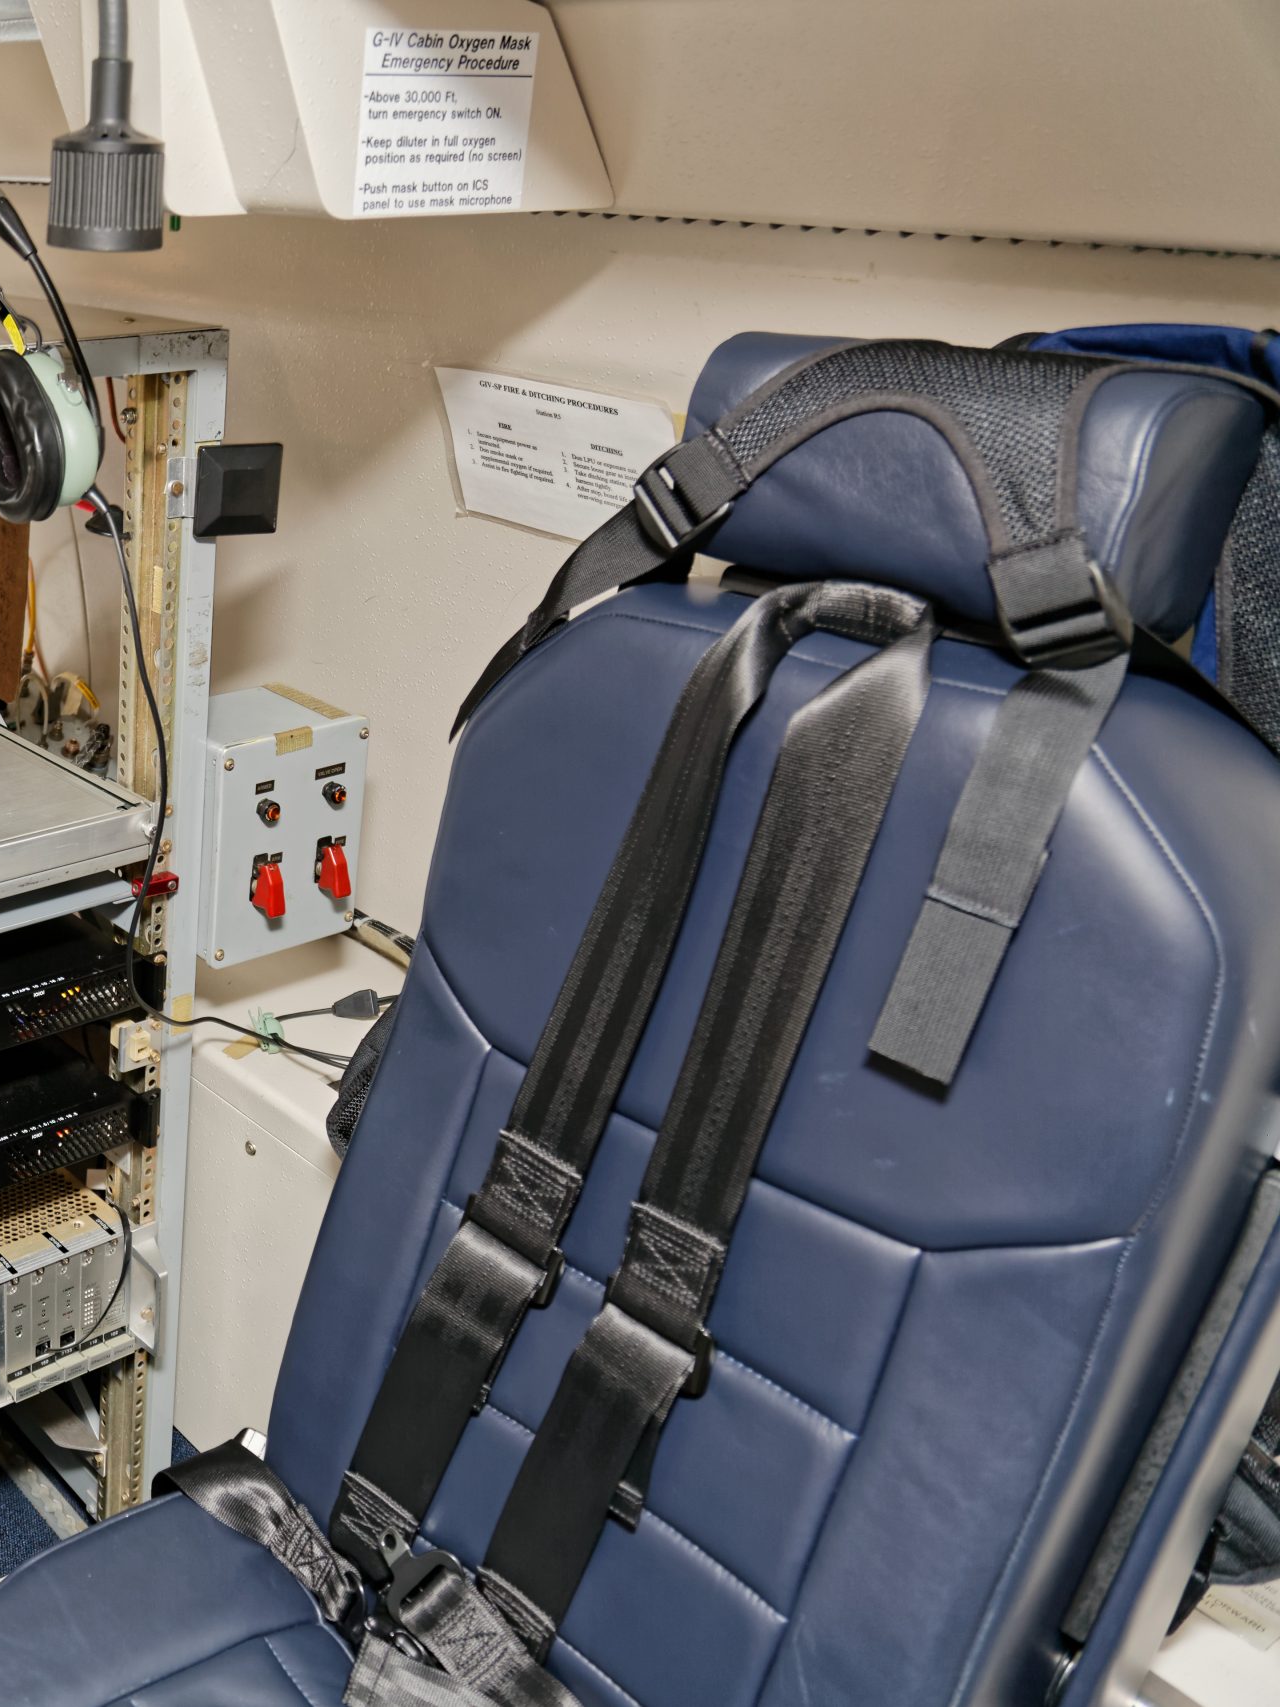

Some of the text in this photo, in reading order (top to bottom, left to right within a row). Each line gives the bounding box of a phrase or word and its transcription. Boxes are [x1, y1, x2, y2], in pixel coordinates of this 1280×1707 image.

[373, 32, 532, 52] G-IV Cabin Oxygen Mask
[382, 53, 520, 72] Emergency Procedure
[364, 92, 400, 103] -Above
[405, 91, 441, 103] 30,000
[369, 107, 502, 121] turn emergency switch ON.
[362, 136, 495, 149] -Keep diluter in full oxygen
[365, 149, 521, 165] position as required (no screen)
[359, 179, 488, 194] -Push mask button on ICS
[363, 194, 512, 211] panel to use mask microphone
[480, 380, 502, 392] GIV-SP
[504, 385, 520, 394] FIRE
[529, 390, 566, 404] DITCHING
[567, 398, 618, 415] PROCEDURES
[536, 409, 553, 418] Station
